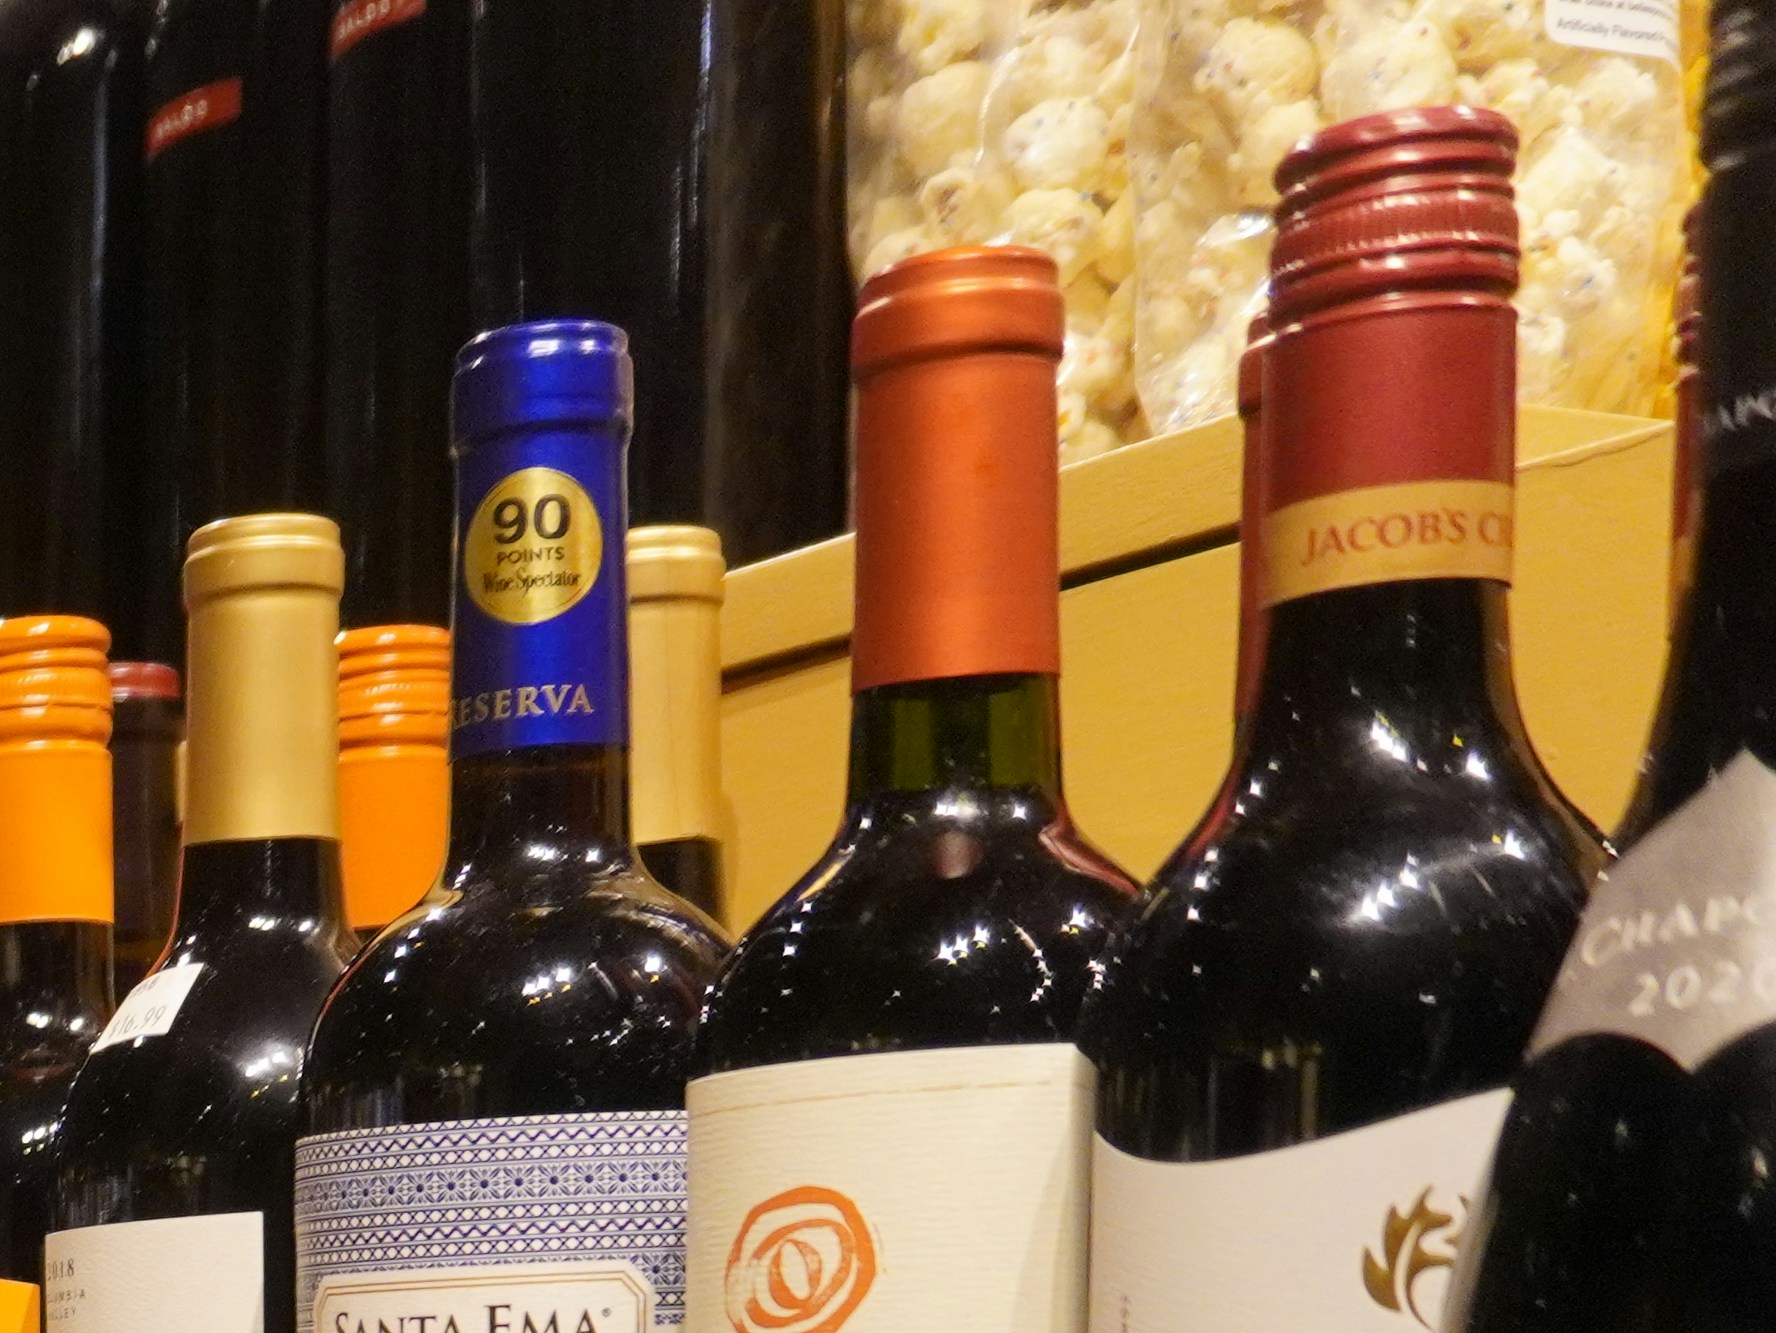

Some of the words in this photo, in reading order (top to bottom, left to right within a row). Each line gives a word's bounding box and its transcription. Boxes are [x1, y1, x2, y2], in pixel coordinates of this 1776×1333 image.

[491, 493, 572, 545] 90
[1300, 507, 1467, 566] JACOB'S
[496, 546, 565, 566] POINTS
